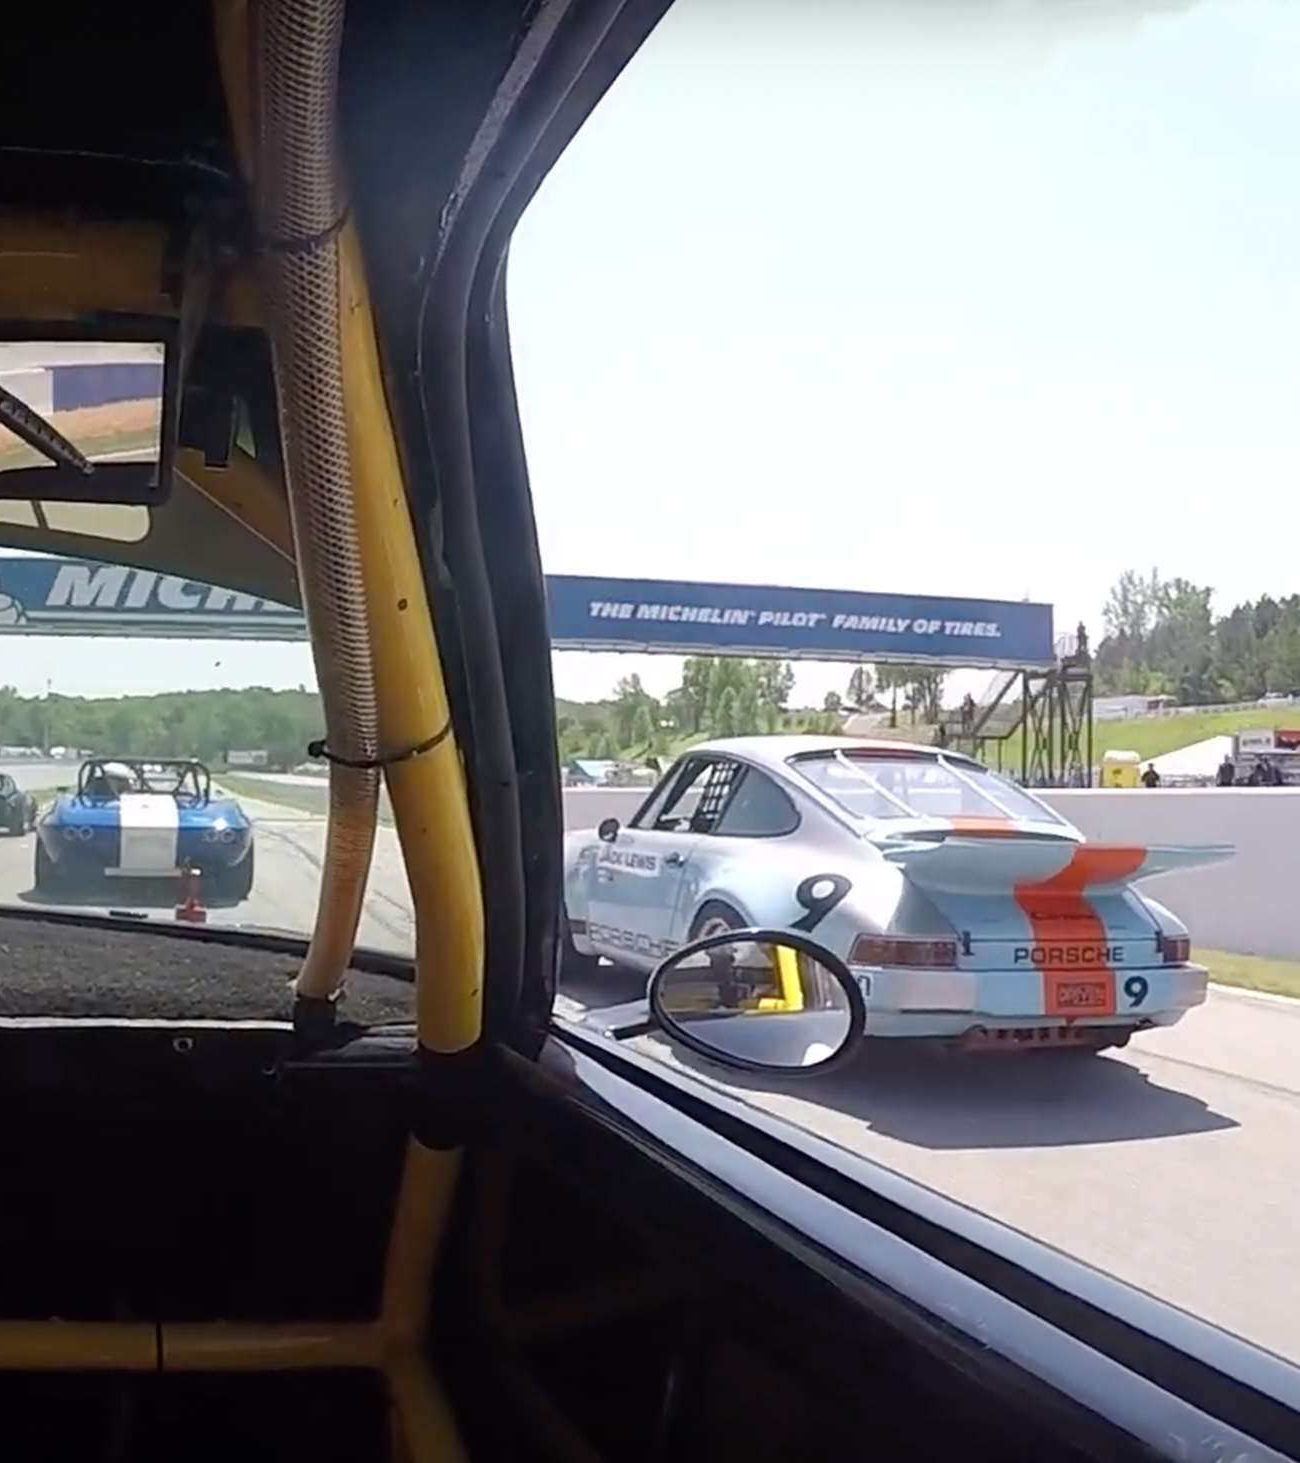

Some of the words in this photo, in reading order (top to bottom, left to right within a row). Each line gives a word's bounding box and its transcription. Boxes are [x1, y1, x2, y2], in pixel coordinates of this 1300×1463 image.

[589, 601, 632, 619] THE
[832, 612, 907, 633] FAMILY
[913, 617, 941, 634] OF
[944, 619, 1002, 637] TIRES.
[790, 873, 853, 933] 9
[1014, 945, 1125, 964] PORSCHE
[1123, 975, 1149, 1008] 9
